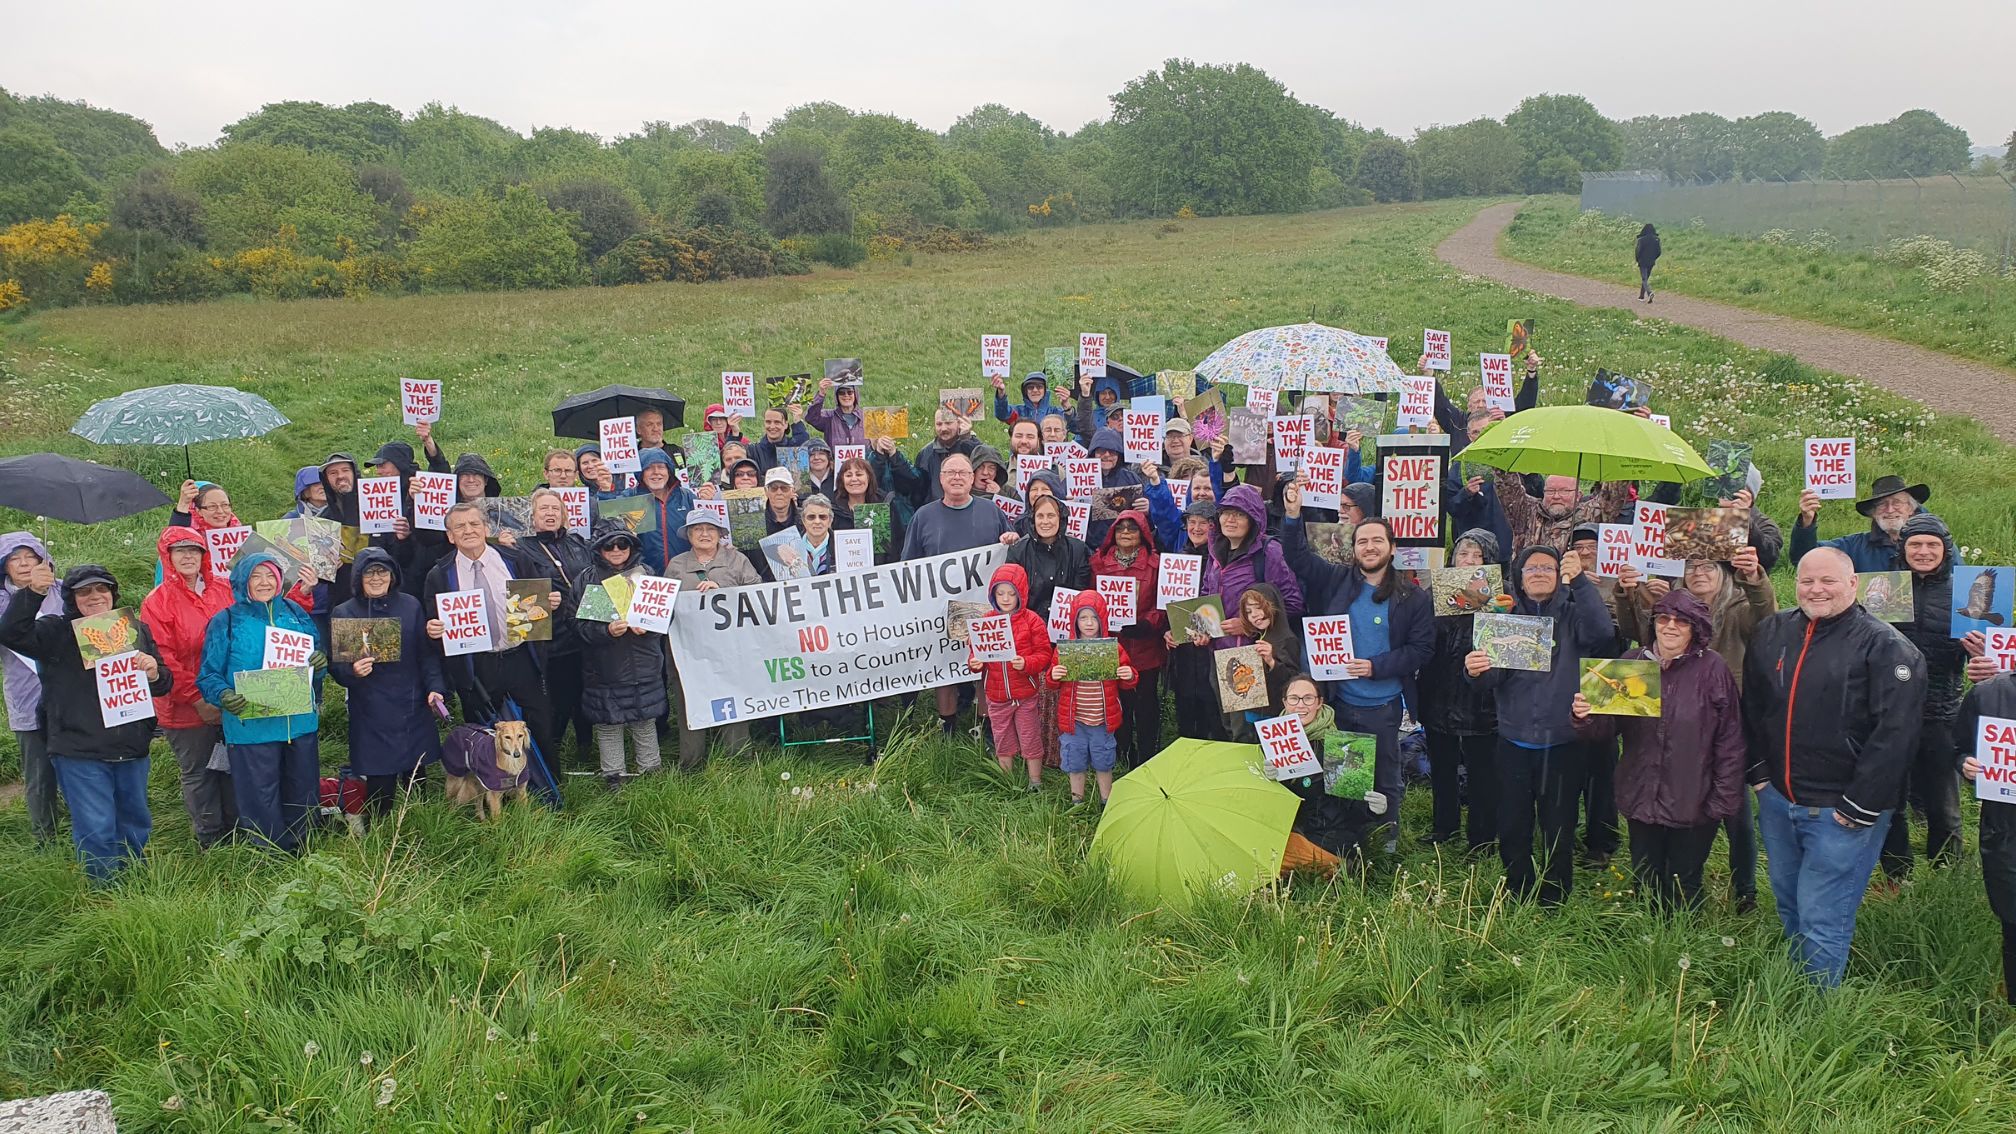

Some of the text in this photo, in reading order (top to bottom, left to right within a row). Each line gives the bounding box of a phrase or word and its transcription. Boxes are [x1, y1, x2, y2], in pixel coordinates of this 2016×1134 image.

[985, 339, 1008, 348] SAVE
[1082, 337, 1104, 346] SAVE
[1426, 332, 1448, 343] SAVE
[987, 349, 1004, 357] THE
[1085, 348, 1100, 357] THE
[1429, 343, 1445, 352] THE
[1082, 358, 1104, 366] WICK!
[1426, 352, 1449, 360] WICK!
[985, 359, 1008, 367] WICK!
[1483, 358, 1508, 371] SAVE
[725, 376, 750, 385] SAVE
[1486, 373, 1505, 385] THE
[405, 383, 437, 393] SAVE
[729, 387, 748, 396] THE
[1485, 386, 1510, 397] WICK!
[409, 395, 433, 405] THE
[726, 398, 752, 406] WICK!
[1254, 391, 1272, 401] THE
[1408, 393, 1428, 404] THE
[406, 406, 438, 415] WICK!
[1402, 405, 1432, 415] WICK!
[1127, 414, 1159, 426] SAVE
[1277, 420, 1310, 432] SAVE
[604, 422, 632, 435] SAVE
[1131, 428, 1155, 439] THE
[607, 436, 629, 448] THE
[1126, 441, 1159, 451] WICK!
[1282, 434, 1306, 446] THE
[604, 449, 636, 460] WICK!
[838, 450, 863, 460] SAVE
[1048, 446, 1066, 455] SAV
[1068, 445, 1086, 459] SAV
[1810, 443, 1851, 456] SAVE
[1020, 459, 1049, 470] SAVE
[1306, 451, 1340, 466] SAVE
[1069, 463, 1098, 473] SAVE
[1387, 459, 1435, 481] SAVE
[1815, 459, 1845, 471] THE
[1309, 467, 1334, 481] THE
[1809, 473, 1852, 485] WICK!
[419, 477, 453, 490] SAVE
[1073, 476, 1095, 486] THE
[362, 481, 396, 494] SAVE
[1304, 481, 1338, 494] WICK!
[368, 496, 393, 508] THE
[423, 491, 448, 504] THE
[562, 492, 586, 502] AVE
[1393, 488, 1427, 510] THE
[418, 505, 449, 516] WICK
[566, 505, 582, 516] HE
[996, 498, 1023, 516] SAVE
[1069, 506, 1087, 518] VE
[364, 509, 399, 520] WICK!
[570, 518, 587, 527] CK!
[1067, 520, 1080, 531] HE
[1389, 516, 1437, 538] WICK
[1603, 529, 1632, 544] SAV
[1644, 526, 1664, 543] TH
[219, 546, 240, 559] TH
[1608, 546, 1628, 561] TH
[1635, 542, 1664, 558] WIC
[1163, 558, 1198, 572] SAVE
[1167, 572, 1191, 585] THE
[640, 580, 676, 594] SAVE
[1100, 580, 1132, 592] SAVE
[1161, 586, 1196, 597] WICK!
[641, 592, 668, 605] THE
[812, 572, 884, 617] THE
[1056, 592, 1074, 604] SA
[1104, 594, 1128, 606] THE
[442, 595, 482, 611] SAVE
[633, 603, 669, 618] WICK!
[1059, 607, 1070, 618] TH
[1108, 608, 1133, 618] ICK!
[449, 611, 478, 626] THE
[972, 619, 1008, 632] SAVE
[1052, 619, 1070, 631] WIC
[1308, 620, 1346, 635] SAVE
[446, 625, 486, 640] WICK!
[798, 616, 946, 653] NO to Housing
[977, 632, 1005, 642] THE
[271, 632, 311, 648] SAVE
[1314, 638, 1344, 651] THE
[1991, 634, 2016, 650] SA
[975, 641, 1012, 652] WICK!
[275, 647, 306, 663] THE
[1311, 652, 1350, 665] WICK!
[764, 656, 806, 683] YES
[810, 663, 831, 677] to
[838, 662, 848, 673] a
[854, 645, 932, 670] Country
[107, 674, 138, 693] THE
[744, 696, 790, 714] Save
[793, 688, 830, 706] The
[836, 665, 944, 699] Middlewick
[104, 689, 148, 709] WICK!
[1260, 719, 1300, 740] SAVE
[1984, 724, 2016, 745] SA
[1270, 737, 1301, 755] THE
[1271, 750, 1313, 768] WICK!
[1991, 746, 2016, 767] TH
